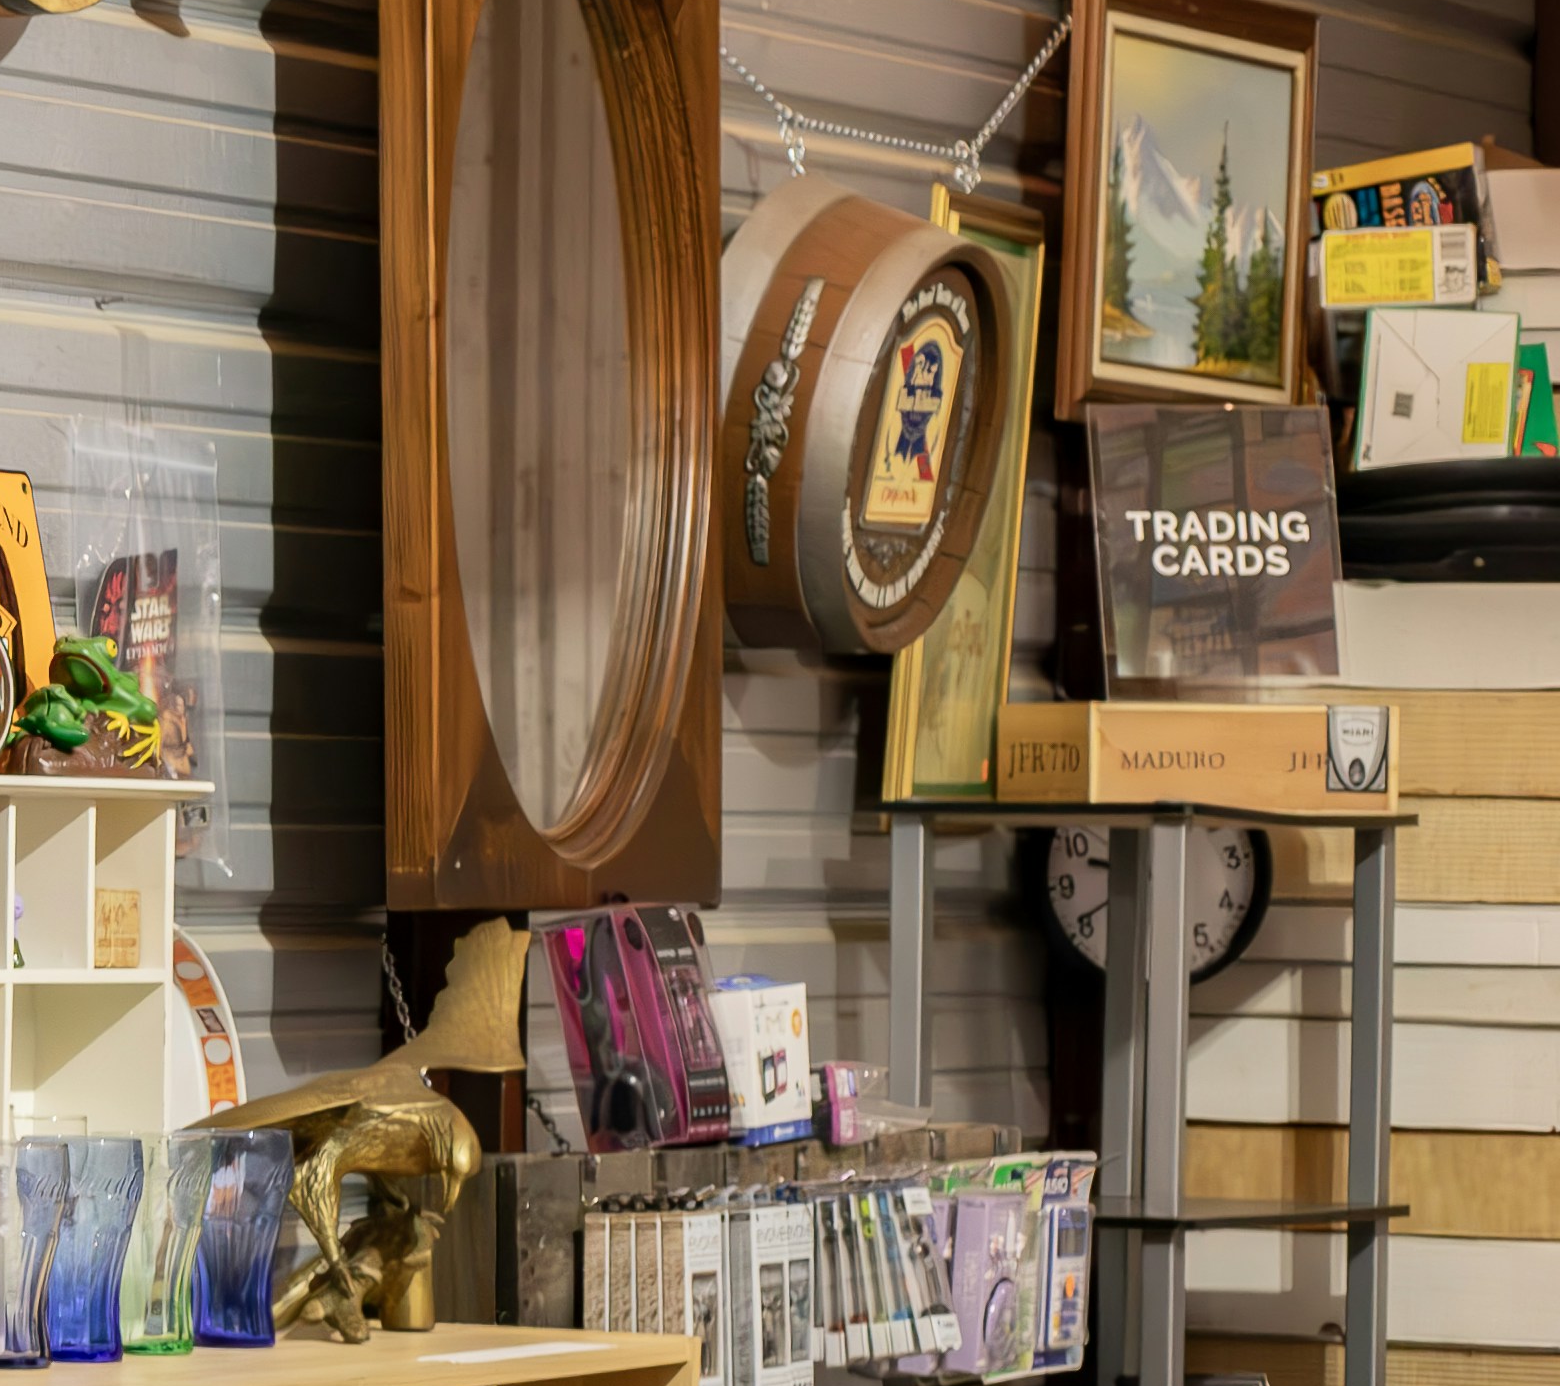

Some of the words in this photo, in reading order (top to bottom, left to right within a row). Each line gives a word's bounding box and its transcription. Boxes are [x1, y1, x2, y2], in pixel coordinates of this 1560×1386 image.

[1123, 507, 1312, 545] TRADING
[1150, 543, 1292, 579] CARDS
[132, 596, 172, 620] STAR
[130, 619, 172, 645] WARS
[1119, 750, 1227, 771] MADURO
[1063, 832, 1089, 859] 10
[1223, 843, 1242, 871] 3
[1057, 873, 1076, 901] 9
[1218, 889, 1235, 911] 4
[1077, 914, 1096, 940] 8
